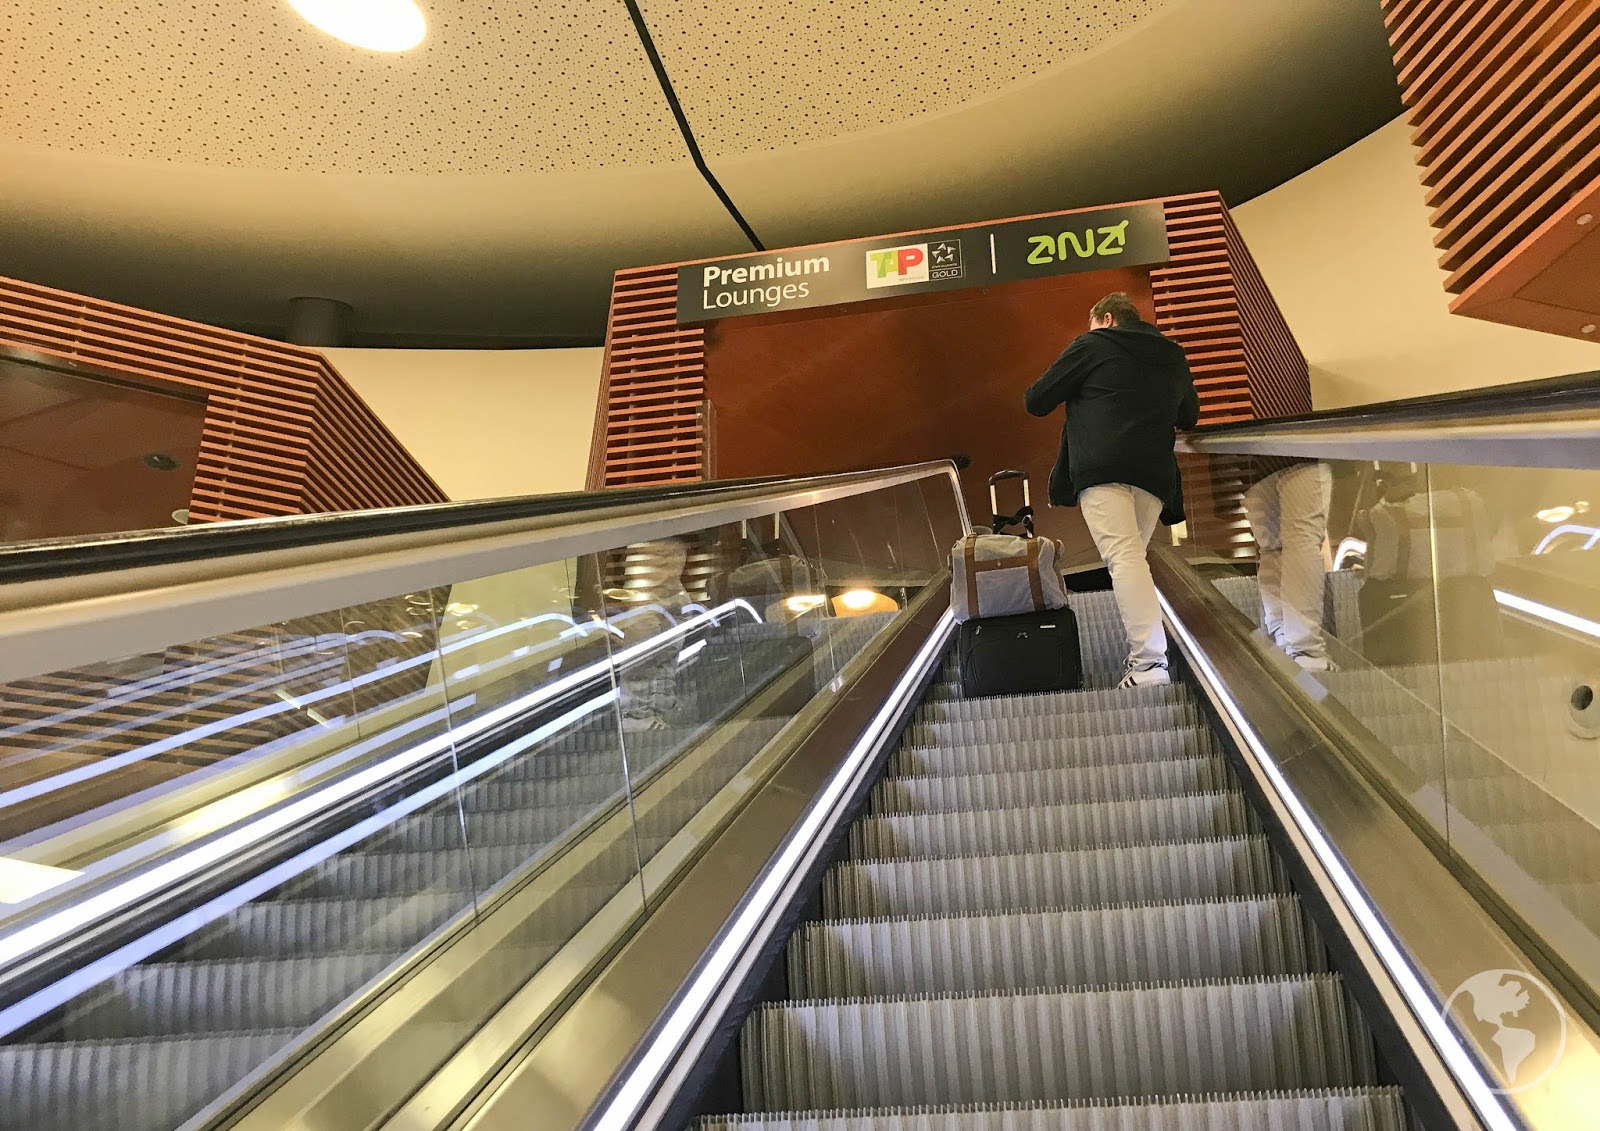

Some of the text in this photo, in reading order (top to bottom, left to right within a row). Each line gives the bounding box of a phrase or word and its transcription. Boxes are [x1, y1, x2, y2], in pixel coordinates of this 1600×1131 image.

[703, 256, 830, 288] Premium
[869, 248, 924, 278] TAP
[931, 269, 958, 279] GOLD
[703, 281, 810, 310] Lounges
